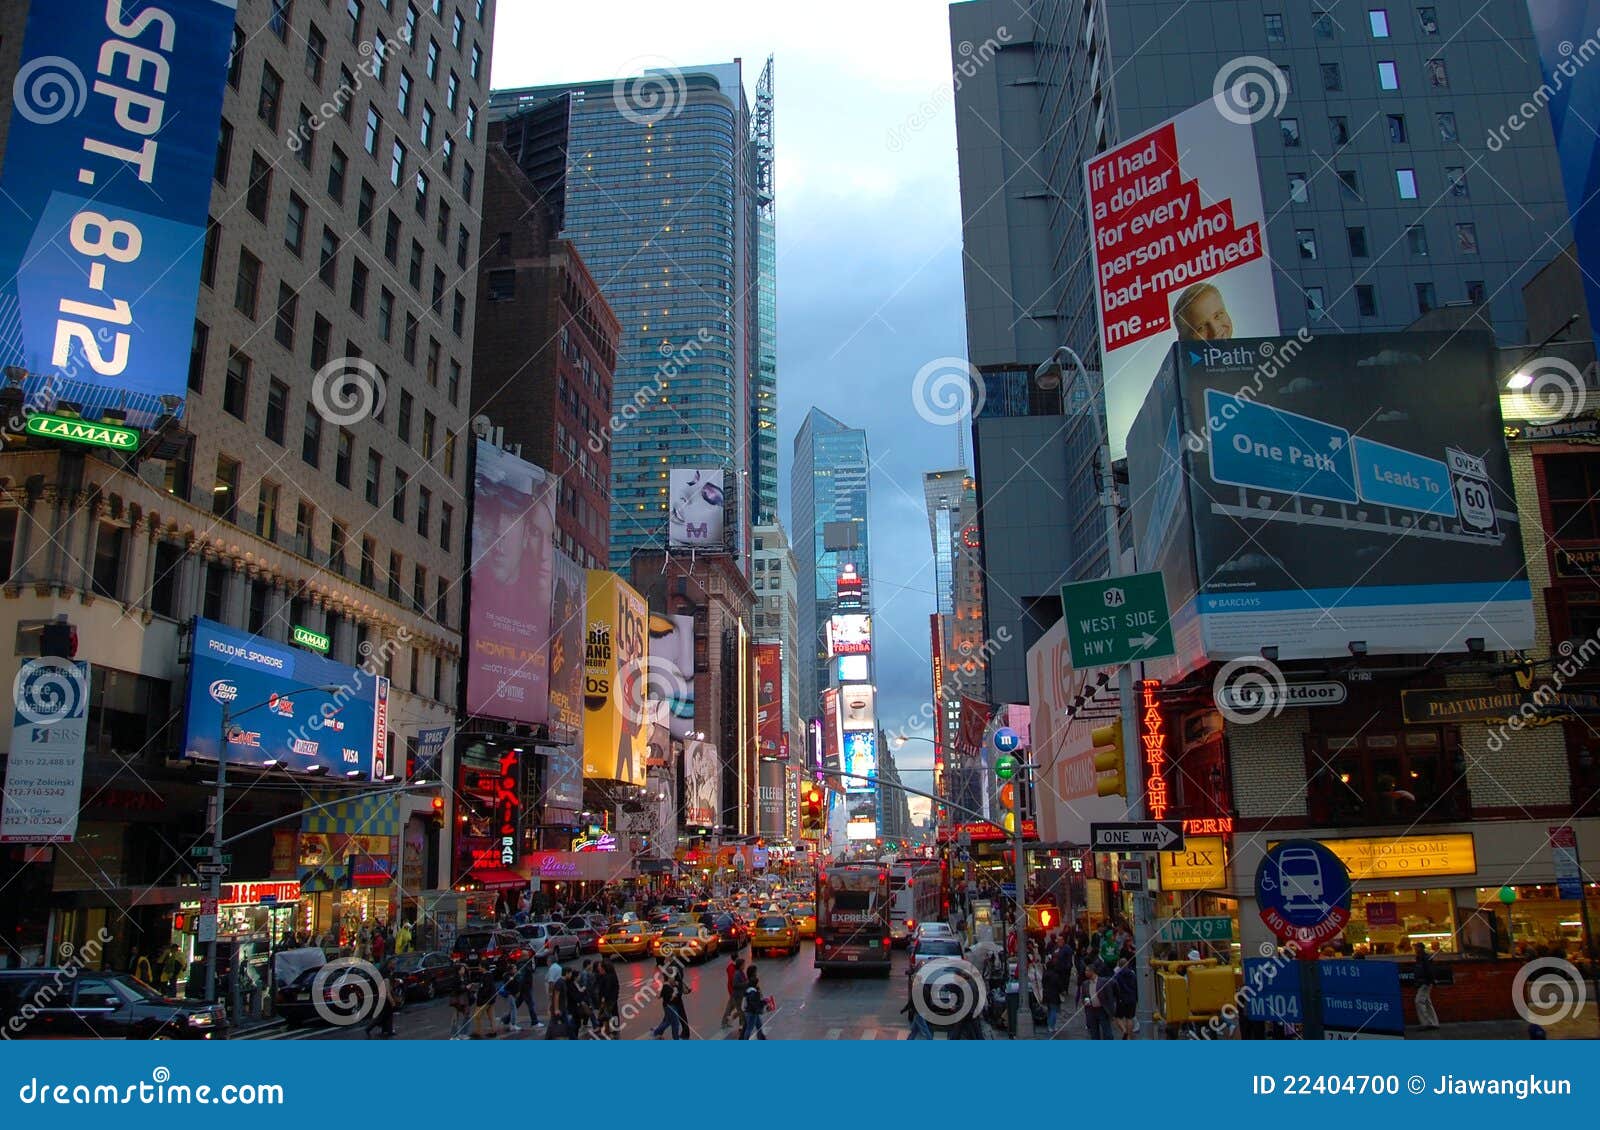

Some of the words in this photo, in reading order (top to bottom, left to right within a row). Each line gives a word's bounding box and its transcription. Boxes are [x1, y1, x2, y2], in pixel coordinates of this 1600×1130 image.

[79, 0, 176, 185] SEPT.
[1091, 165, 1107, 191] If
[1108, 165, 1115, 183] I
[1117, 140, 1157, 177] had
[1094, 203, 1108, 220] a
[1110, 168, 1172, 213] dollar
[1097, 222, 1127, 250] for
[1131, 193, 1192, 234] every
[1101, 236, 1175, 286] person
[1178, 212, 1227, 247] who
[1104, 230, 1256, 312] bad-mouthed
[51, 211, 143, 376] 8-12
[1107, 314, 1142, 344] me
[1203, 346, 1254, 366] iPath
[38, 419, 130, 446] LAMAR
[1233, 433, 1282, 461] One
[1288, 445, 1336, 473] Path
[1373, 463, 1421, 490] Leads
[1422, 476, 1440, 496] To
[1454, 456, 1483, 473] OVER
[1464, 486, 1486, 511] 60
[1105, 592, 1123, 604] 9A
[1218, 598, 1260, 607] BARCLAYS
[616, 592, 645, 657] tbs
[1080, 616, 1116, 634] WEST
[1125, 610, 1158, 628] SIDE
[297, 632, 328, 649] LAMAR
[833, 643, 871, 652] TOSHIBA
[1083, 638, 1114, 656] HWY
[209, 640, 235, 656] PROUD
[234, 647, 249, 660] NFL
[249, 652, 284, 669] SPONSORS
[585, 645, 611, 659] ANG
[585, 658, 607, 667] HEORY
[20, 683, 51, 697] Space
[217, 683, 238, 695] BUD
[586, 676, 609, 693] bs
[1269, 686, 1337, 700] outdoor
[213, 690, 239, 701] LIGHT
[1429, 693, 1521, 716] PLAYWRIGHT
[17, 703, 69, 714] Available
[52, 728, 80, 741] SRS
[376, 702, 386, 760] KICKOFF
[342, 748, 359, 763] VISA
[9, 778, 33, 787] Corey
[7, 788, 65, 797] 212.710.5242
[1103, 831, 1131, 843] ONE
[1142, 831, 1170, 843] WAY
[502, 836, 513, 864] BAR
[1168, 847, 1216, 868] Pax
[1358, 842, 1449, 856] WHOLESOME
[1359, 857, 1449, 871] FOODS
[241, 884, 248, 902] &
[1172, 921, 1185, 939] W
[1191, 920, 1214, 938] 49
[1216, 919, 1228, 929] ST
[1267, 911, 1284, 930] NO
[1322, 966, 1333, 976] W
[1336, 966, 1347, 977] 14
[1350, 965, 1360, 977] St
[1250, 995, 1299, 1018] M104
[1326, 997, 1353, 1009] Times
[1355, 999, 1390, 1013] Square
